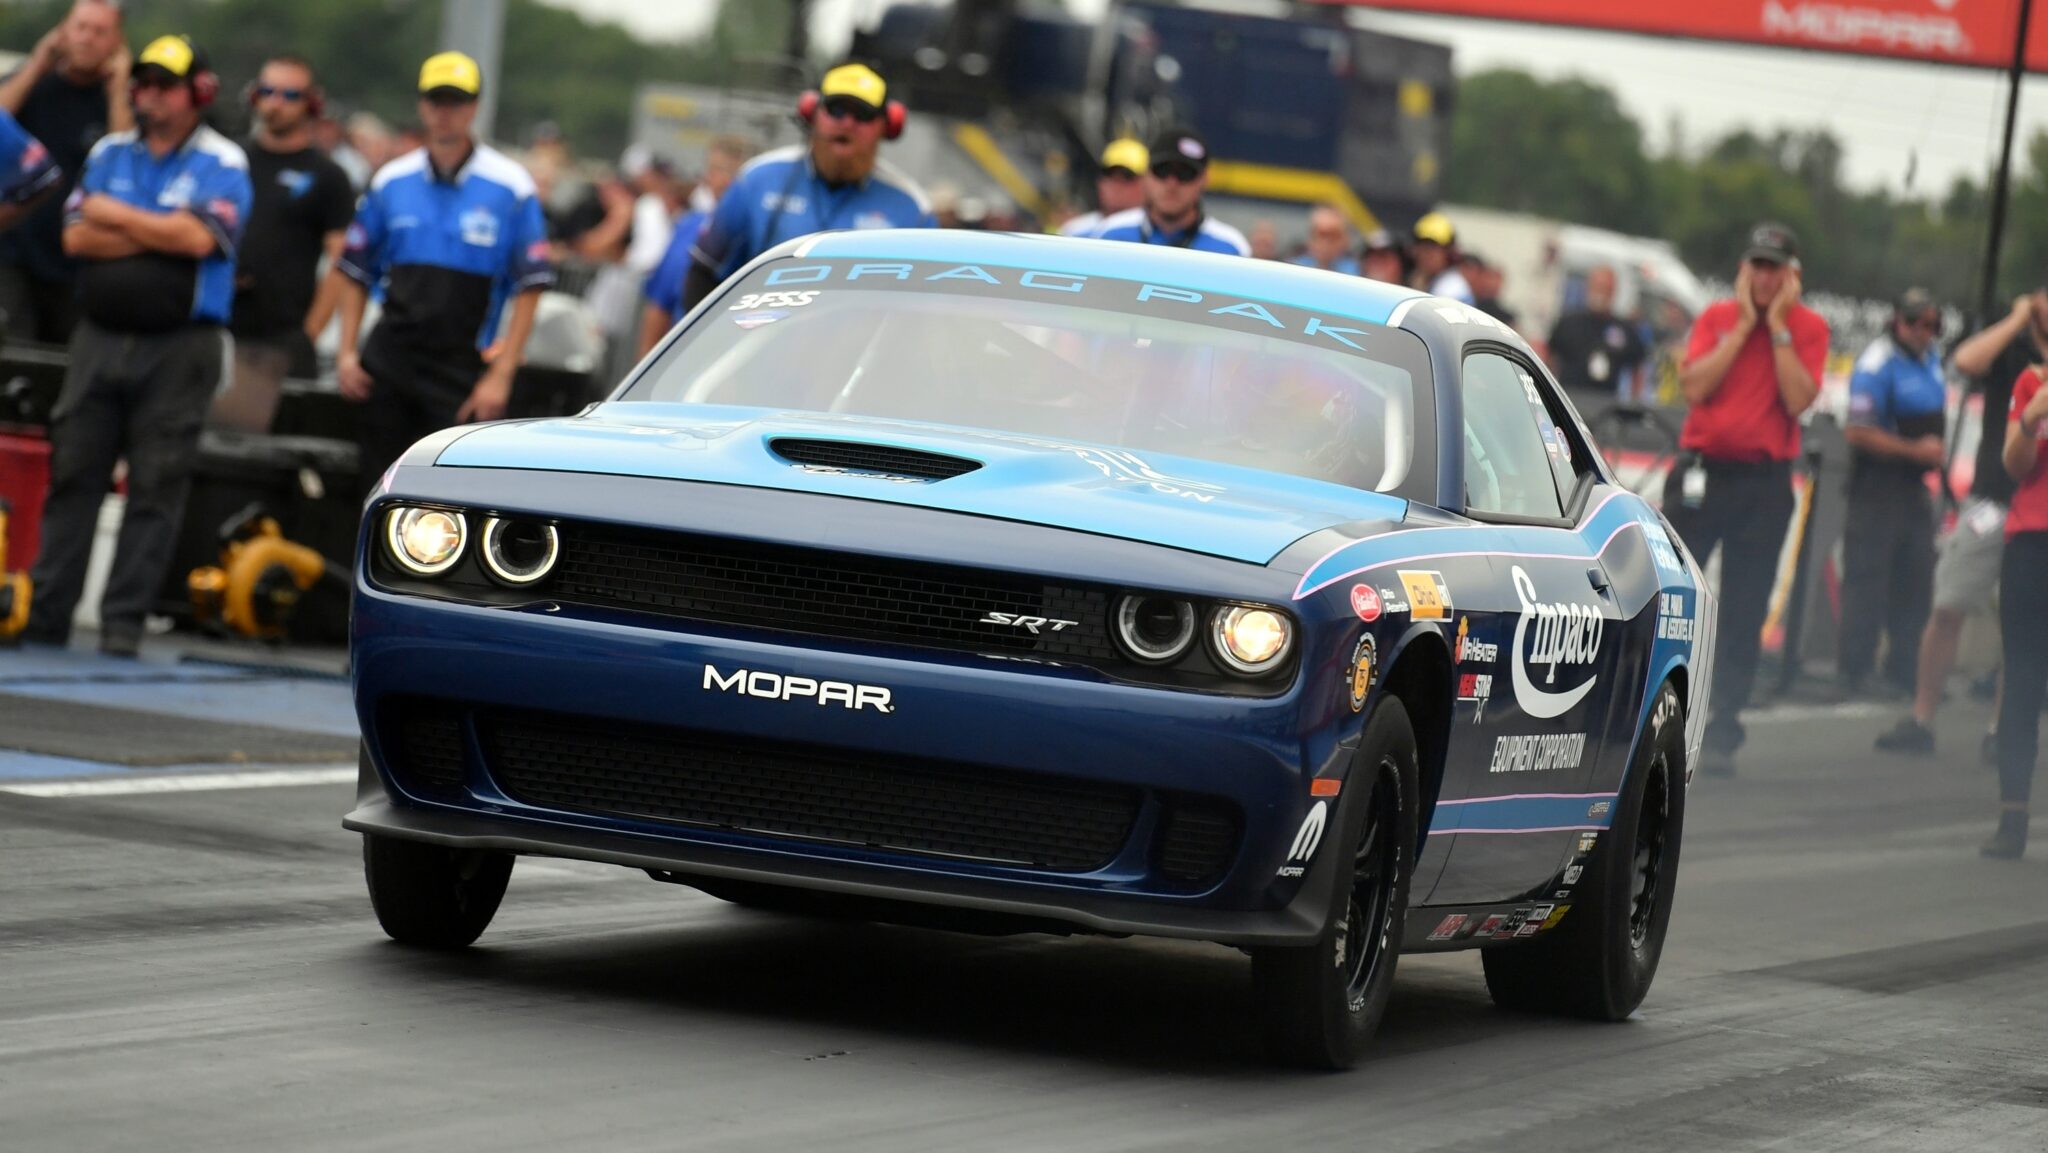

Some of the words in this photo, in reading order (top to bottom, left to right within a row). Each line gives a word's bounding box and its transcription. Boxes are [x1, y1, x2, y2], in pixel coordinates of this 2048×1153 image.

[728, 290, 821, 311] 3FSS
[764, 263, 1088, 293] DRAG
[1136, 284, 1372, 351] PAK
[979, 611, 1079, 634] SRT
[1511, 565, 1603, 719] Empaco
[703, 664, 895, 713] MOPAR
[1490, 735, 1540, 773] EQUIPMENT
[1534, 732, 1587, 771] CORPORATION
